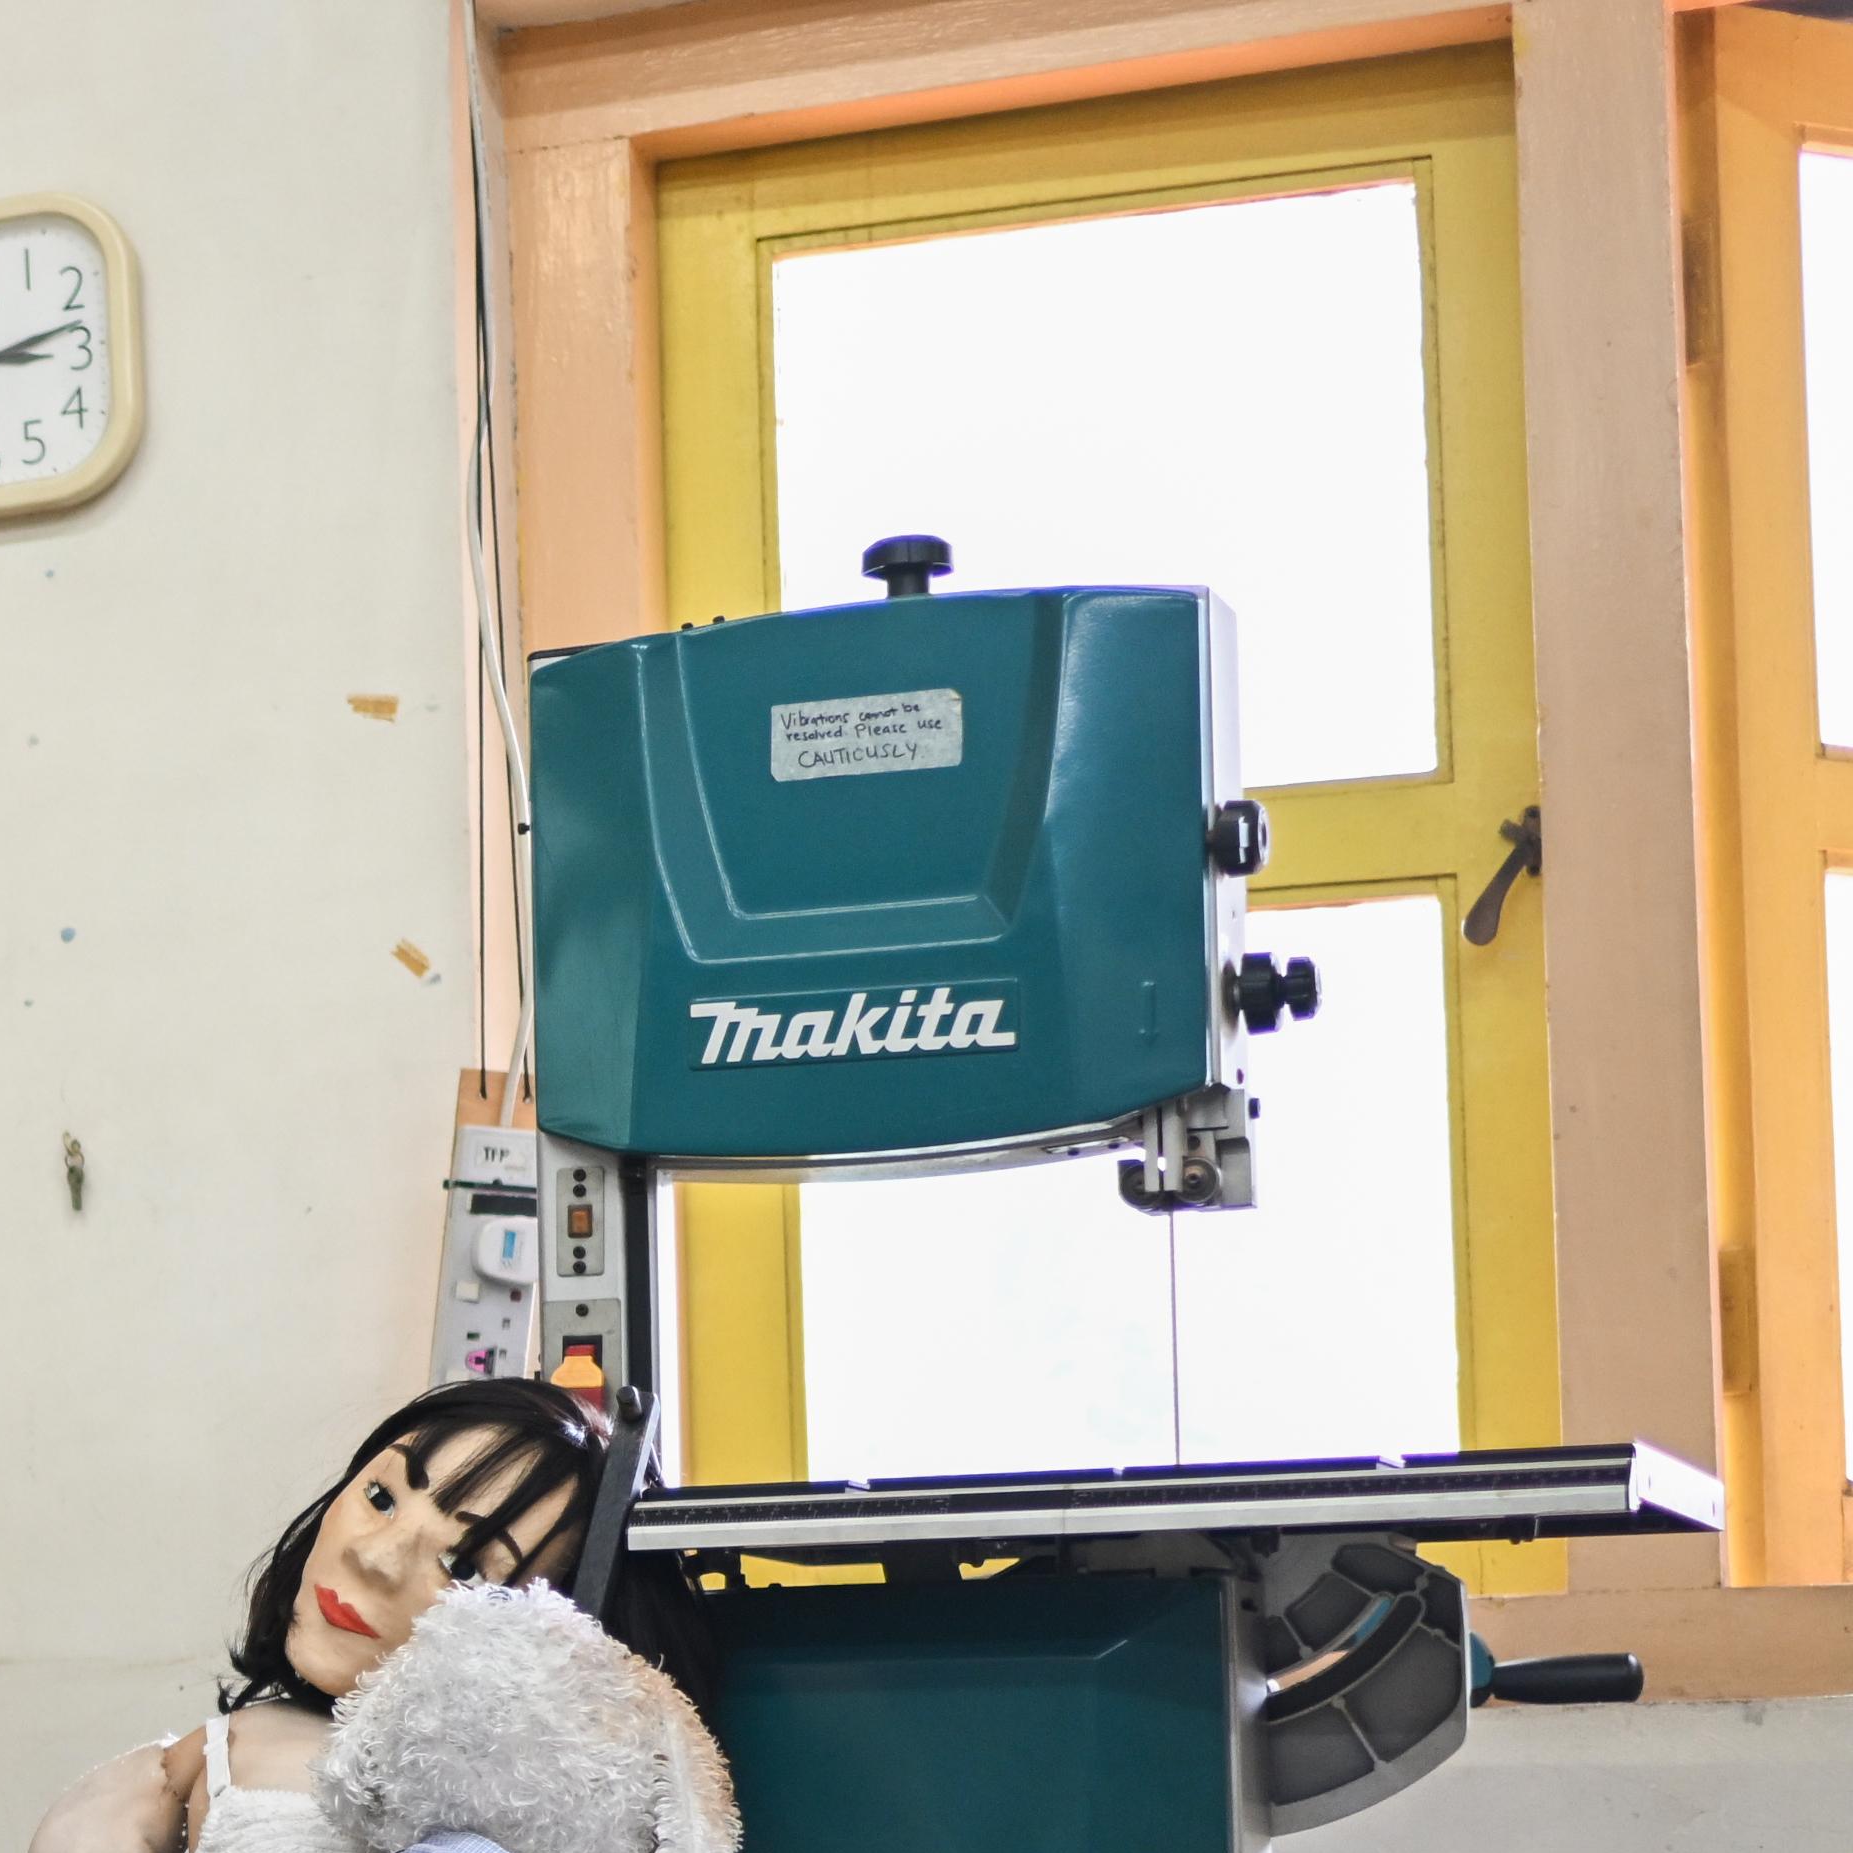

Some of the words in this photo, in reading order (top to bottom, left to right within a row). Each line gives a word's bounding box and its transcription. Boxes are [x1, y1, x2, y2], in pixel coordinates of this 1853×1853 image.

[24, 248, 32, 291] 1
[58, 265, 86, 311] 2
[67, 325, 94, 371] 3
[61, 384, 89, 430] 4
[21, 419, 46, 465] 5
[781, 710, 850, 730] Vibrations
[901, 703, 921, 713] be
[854, 722, 907, 739] Please
[917, 718, 942, 731] use
